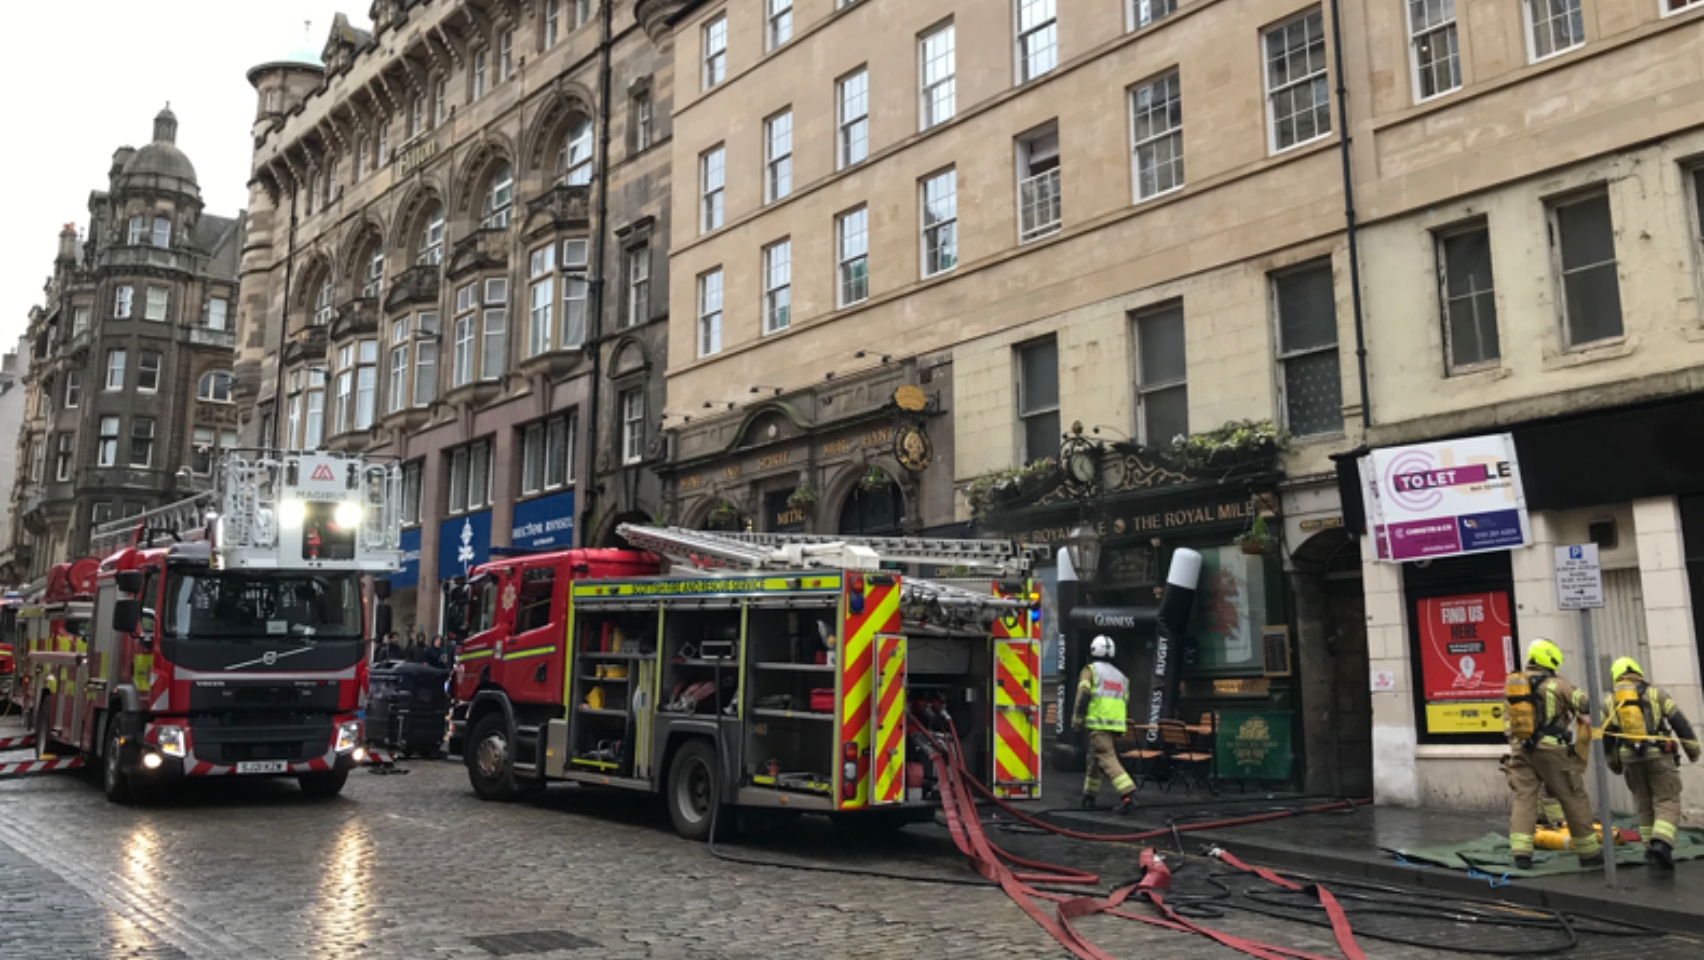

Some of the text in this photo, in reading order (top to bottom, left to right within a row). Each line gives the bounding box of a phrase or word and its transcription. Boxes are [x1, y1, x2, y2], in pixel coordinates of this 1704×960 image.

[1401, 475, 1424, 489] TO
[1426, 471, 1457, 487] LET
[1133, 500, 1255, 532] THE ROYAL MILE
[1094, 613, 1135, 627] GUINNESS
[1441, 605, 1485, 624] FIND US
[1451, 624, 1478, 639] HERE
[1058, 633, 1066, 670] RUGBY
[1155, 636, 1169, 676] RUGBY
